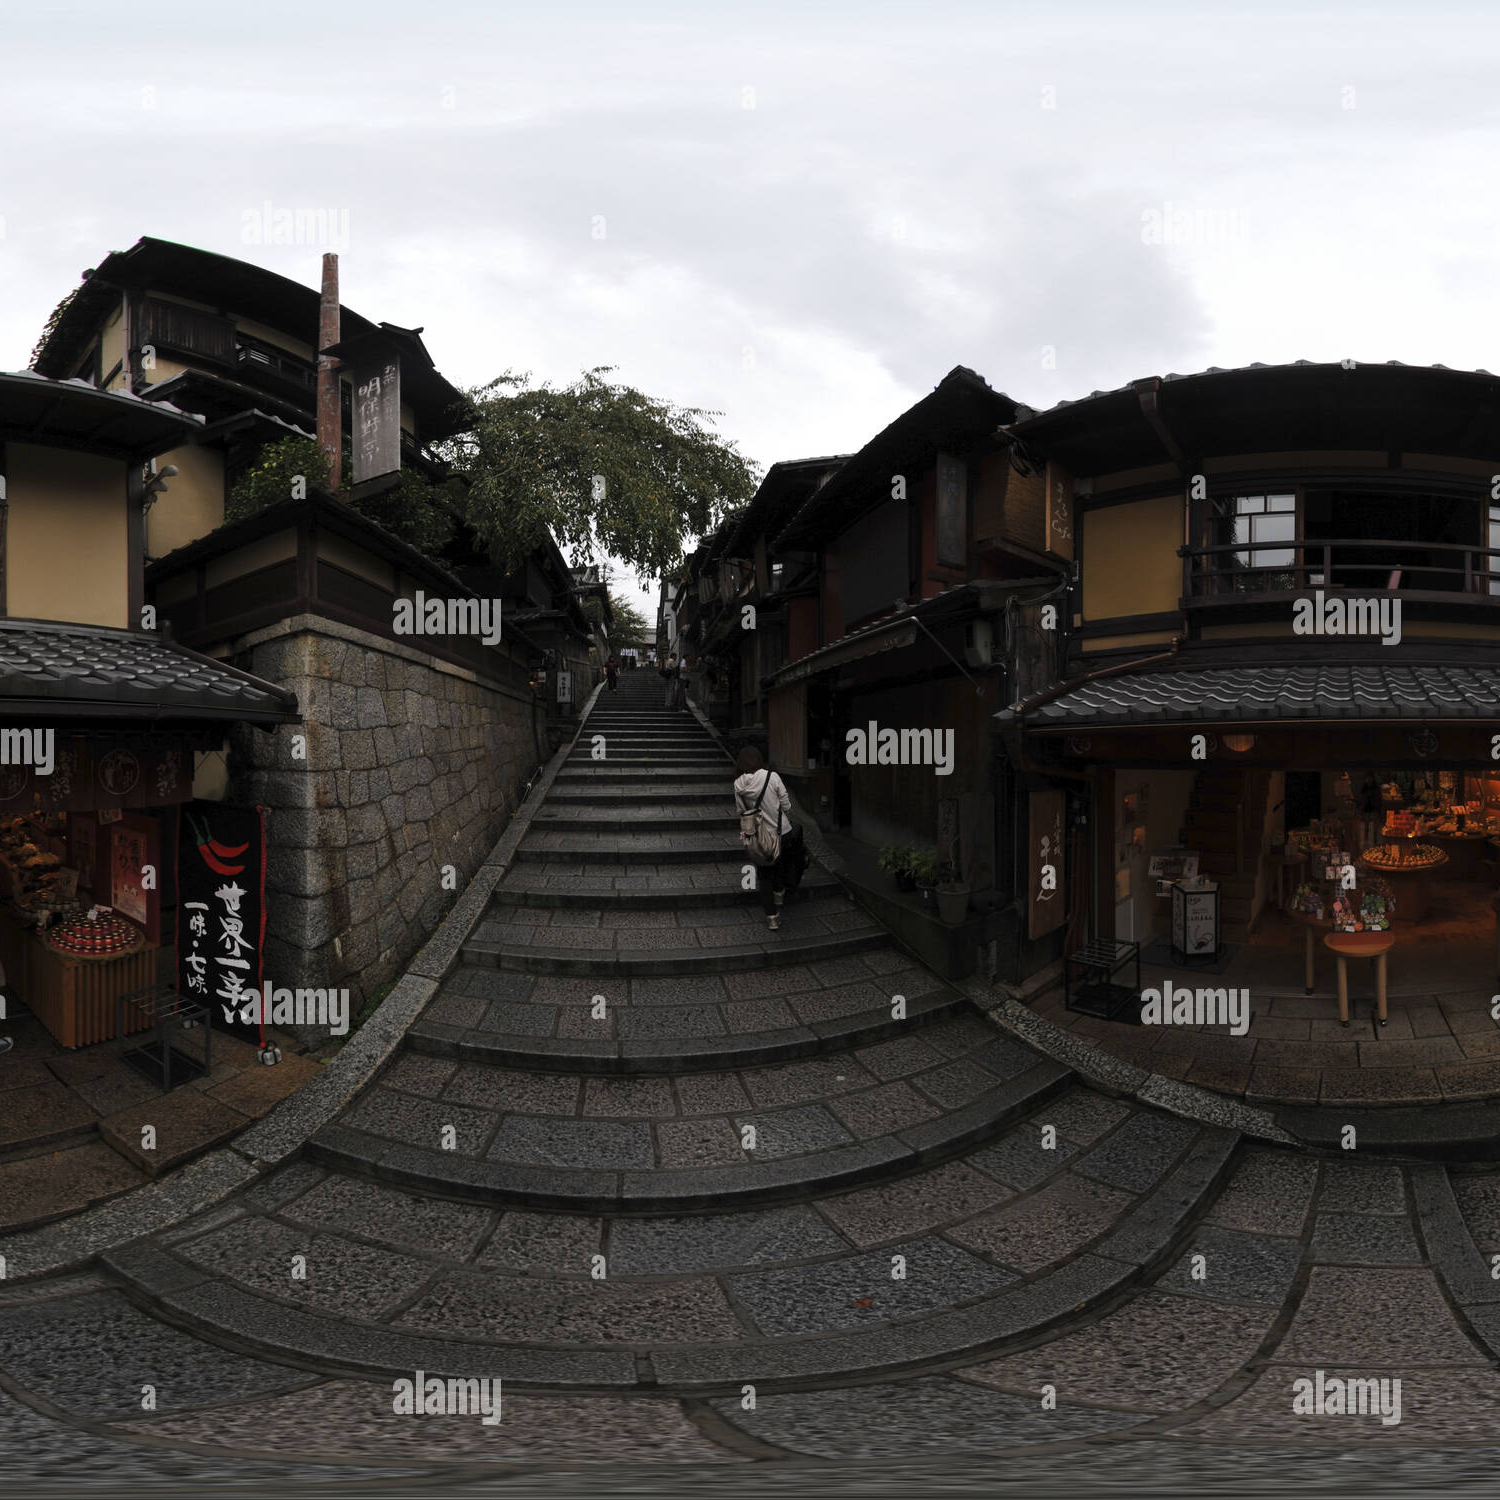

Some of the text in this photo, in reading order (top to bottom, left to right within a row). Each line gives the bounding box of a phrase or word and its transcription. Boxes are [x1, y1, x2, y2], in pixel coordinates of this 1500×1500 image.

[357, 376, 382, 464] 明保野亭
[184, 900, 210, 996] 一味・七味
